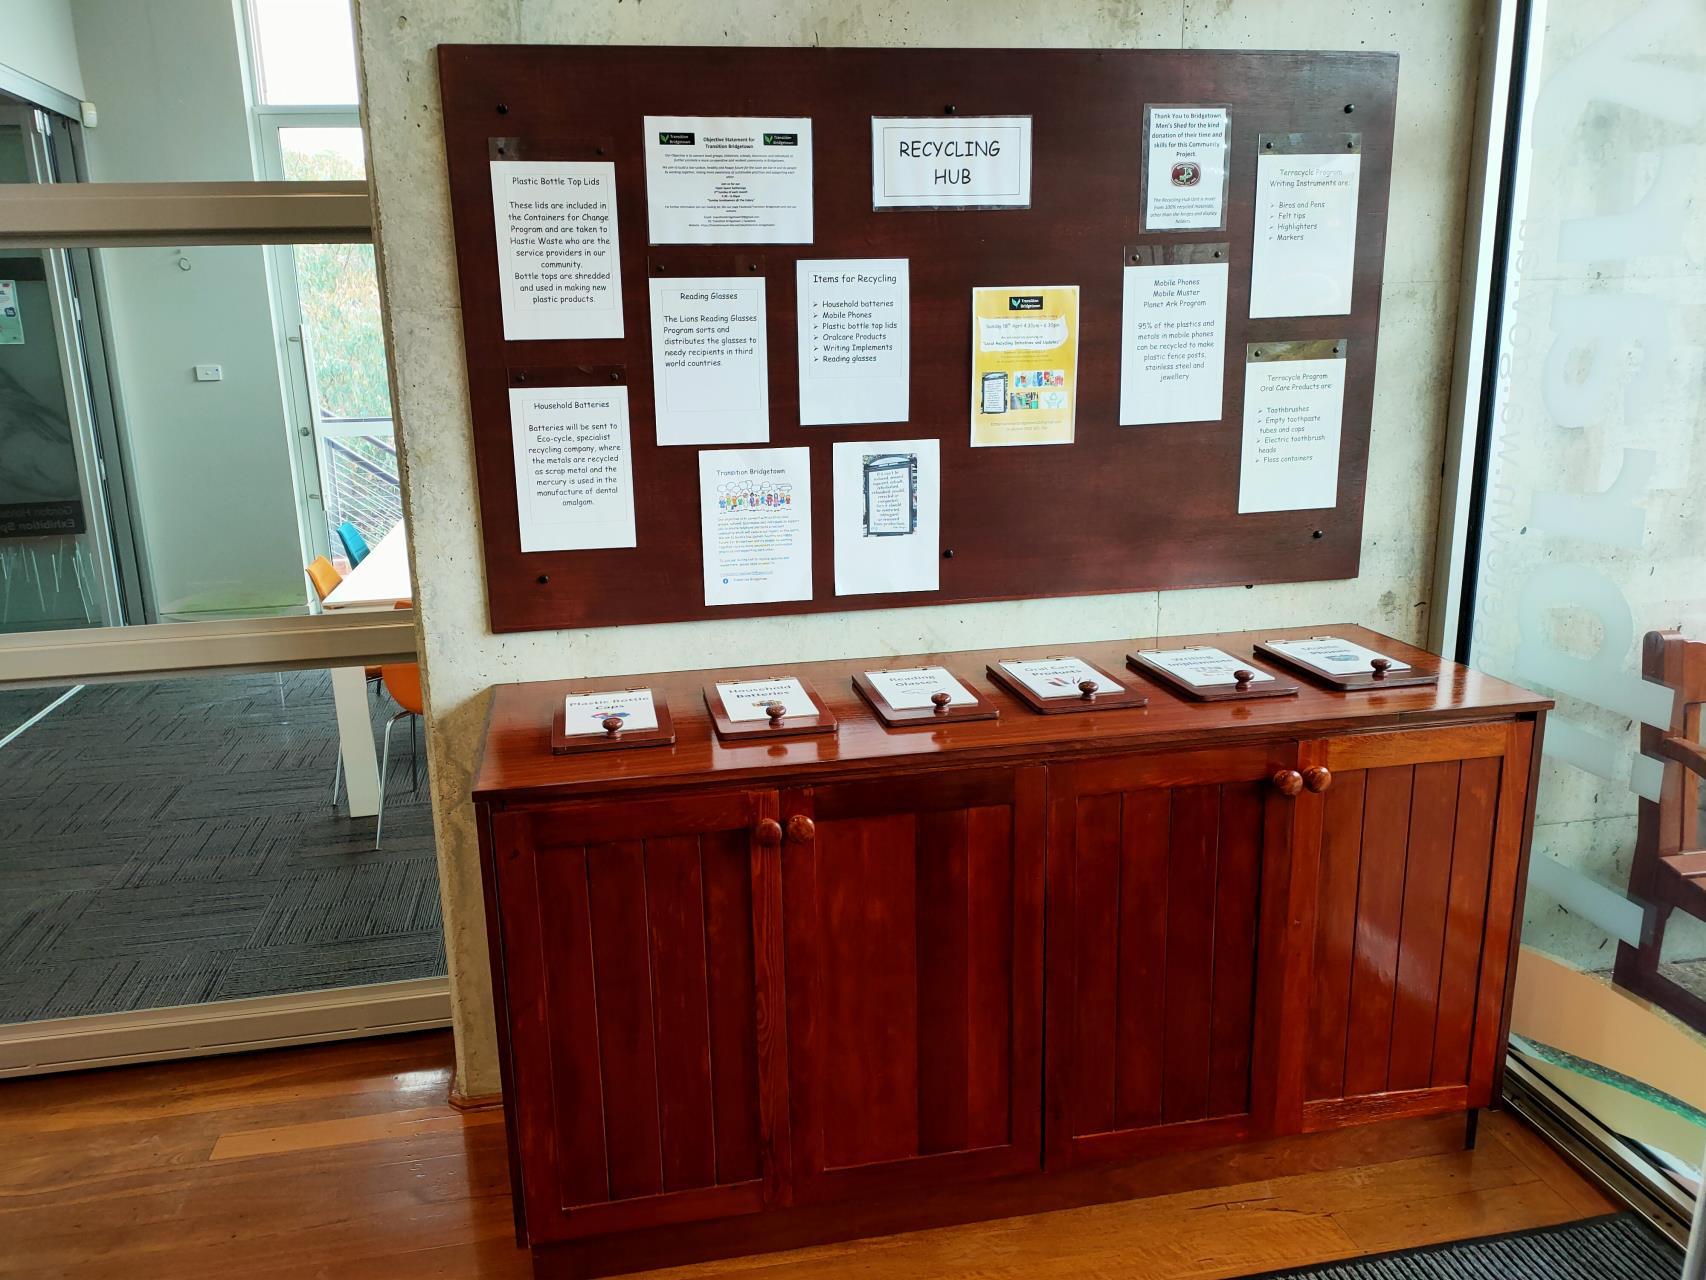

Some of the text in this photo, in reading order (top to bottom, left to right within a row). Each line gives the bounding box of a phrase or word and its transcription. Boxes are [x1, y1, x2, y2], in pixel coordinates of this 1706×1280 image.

[899, 140, 1001, 158] RECYCLING
[934, 168, 972, 185] HUB
[512, 177, 600, 187] Plastic Bottle Top Lids
[509, 201, 533, 210] These
[535, 201, 549, 210] lids
[566, 202, 598, 210] included
[599, 202, 607, 210] in
[567, 214, 580, 222] for
[582, 214, 609, 223] Change
[510, 237, 536, 245] Hastie
[538, 237, 563, 245] Waste
[541, 273, 558, 281] tops
[574, 272, 611, 280] shredded
[813, 274, 897, 284] Items for Recycling
[1154, 279, 1176, 287] Mobile
[532, 295, 558, 304] plastic
[680, 292, 738, 301] Reading Glasses
[822, 299, 894, 308] Household batteries
[1144, 301, 1163, 309] Planet
[1180, 300, 1207, 309] Program
[664, 314, 758, 324] The Lions Reading Glasses
[663, 326, 694, 336] Program
[822, 322, 846, 330] Plastic
[871, 323, 883, 331] top
[822, 333, 854, 341] Oralcare
[664, 349, 686, 358] needy
[688, 348, 725, 357] recipients
[823, 344, 893, 354] Writing Implements
[665, 359, 686, 367] world
[822, 355, 877, 363] Reading glasses
[533, 401, 610, 410] Household Batteries
[528, 424, 564, 432] Batteries
[565, 423, 578, 431] will
[536, 434, 611, 443] Eco-cycle, specialist
[528, 445, 562, 454] recycling
[563, 446, 597, 454] company,
[546, 456, 572, 464] metals
[587, 455, 619, 463] recycled
[536, 486, 618, 497] manufacture of dental
